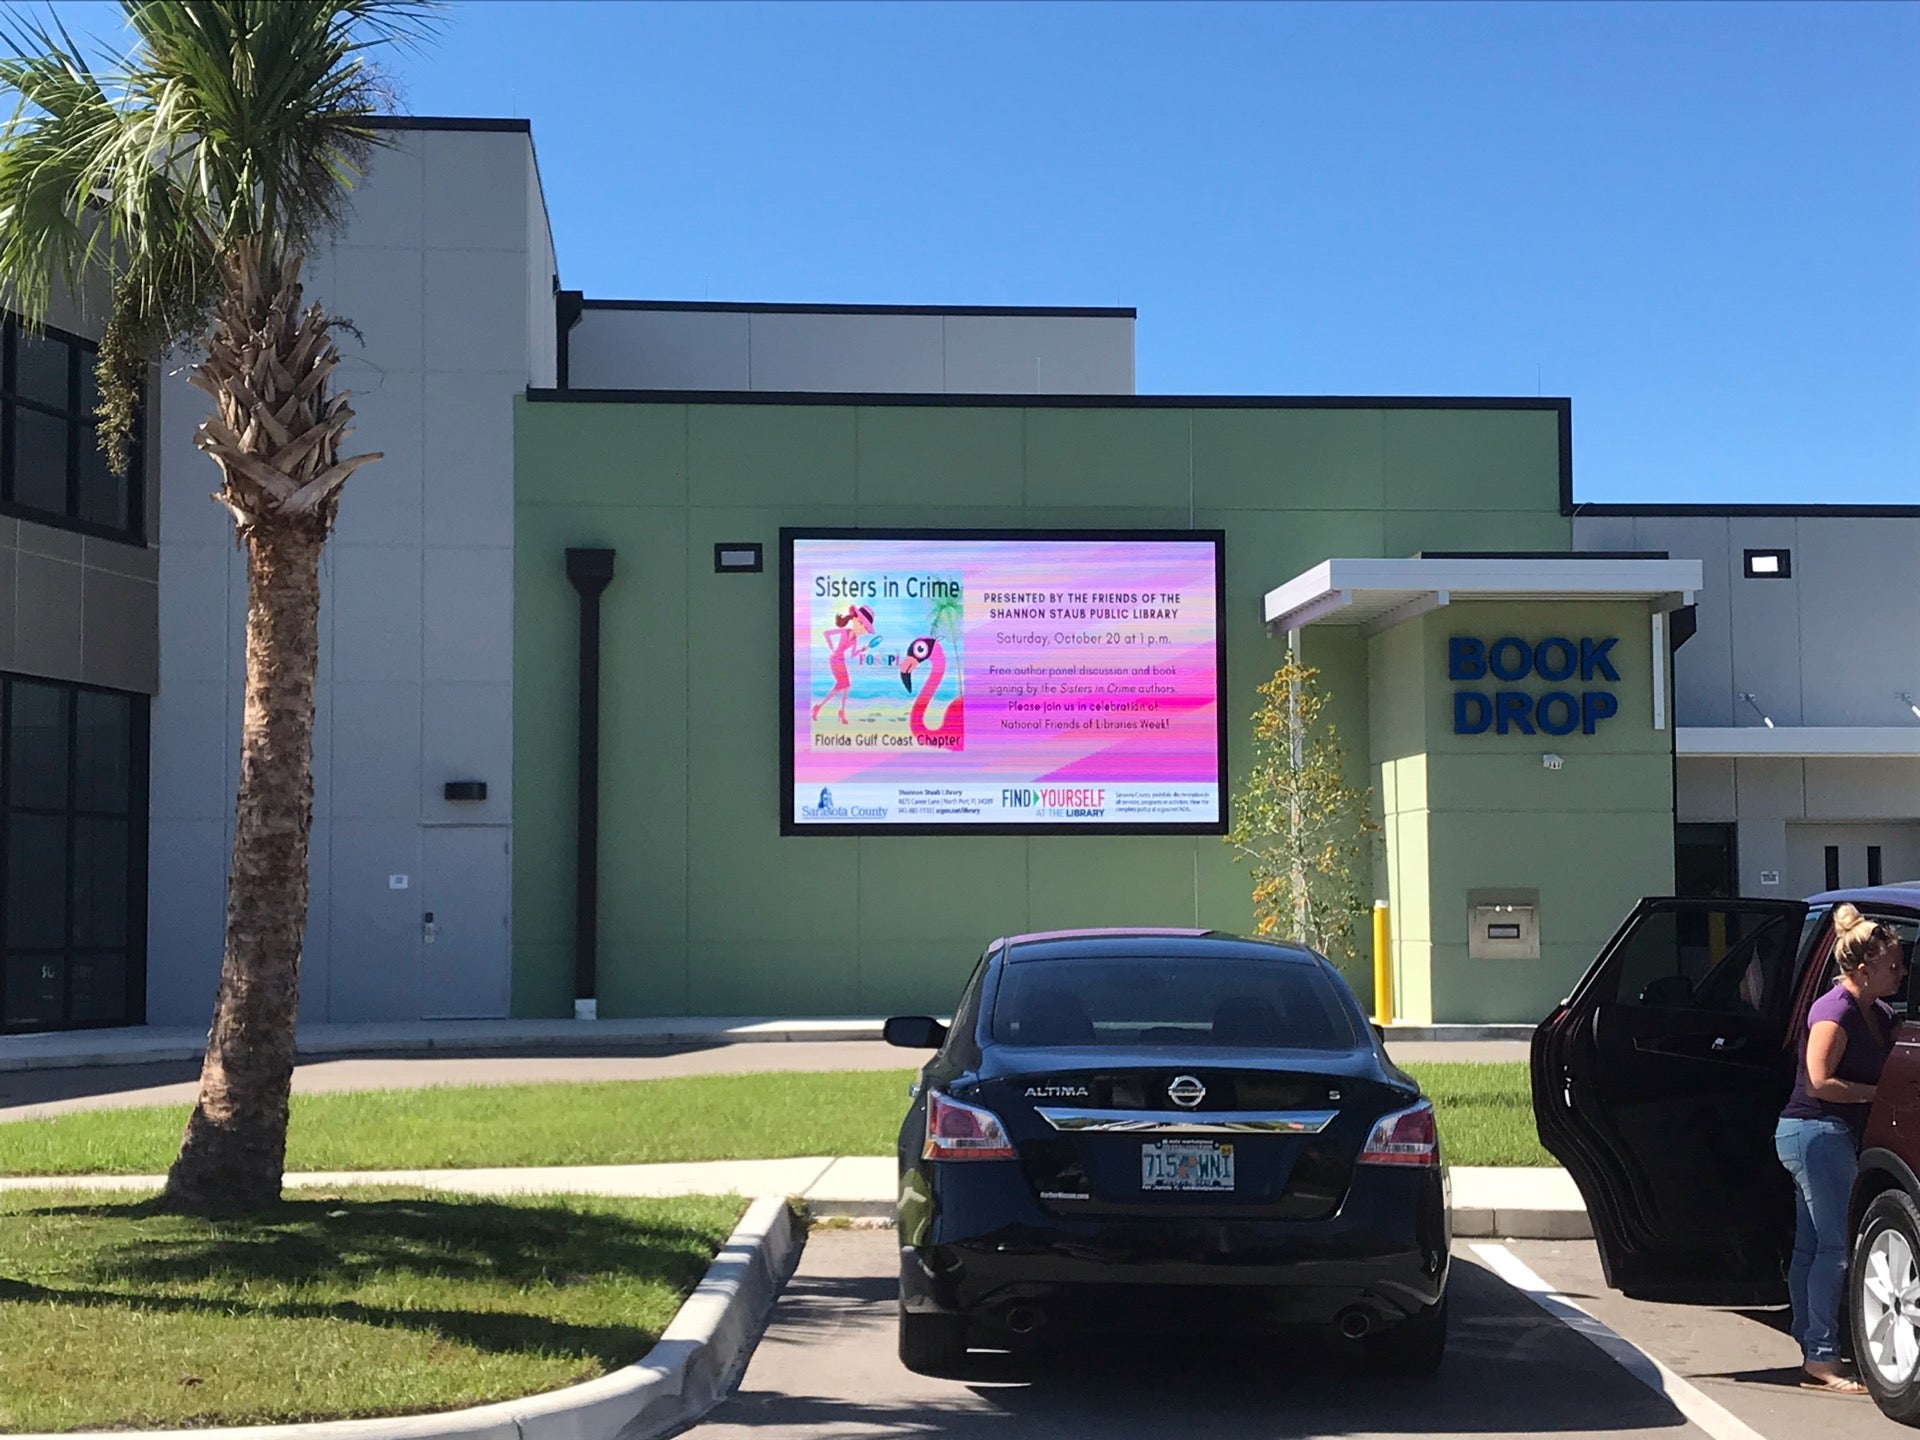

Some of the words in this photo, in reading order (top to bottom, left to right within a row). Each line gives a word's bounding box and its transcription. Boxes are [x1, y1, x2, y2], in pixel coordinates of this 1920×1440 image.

[815, 576, 877, 598] Sisters
[884, 576, 899, 598] in
[906, 576, 960, 598] Crime
[984, 593, 1045, 603] PRESENTED
[1050, 593, 1063, 603] BY
[1068, 593, 1088, 603] THE
[1092, 593, 1138, 603] FRIENDS
[1142, 593, 1156, 603] OF
[1160, 593, 1180, 604] THE
[990, 609, 1045, 619] SHANNON
[1050, 609, 1086, 619] STAUB
[1090, 609, 1128, 619] PUBLIC
[1133, 609, 1178, 619] LIBRARY
[997, 632, 1050, 647] Saturday,
[1054, 632, 1101, 645] October
[1106, 632, 1120, 645] 20
[1124, 633, 1136, 645] at
[1147, 635, 1171, 647] p.m.
[1449, 636, 1621, 682] BOOK
[989, 665, 1011, 675] Free
[1014, 665, 1046, 675] author
[1049, 665, 1076, 678] panel
[1079, 665, 1128, 675] discussion
[1131, 665, 1150, 675] and
[1153, 665, 1176, 675] book
[989, 683, 1023, 696] signing
[1026, 683, 1037, 696] by
[1041, 683, 1057, 693] the
[1060, 683, 1092, 693] Sisters
[1095, 683, 1104, 693] in
[1107, 683, 1136, 693] Crime
[1008, 701, 1041, 711] Please
[1043, 702, 1061, 713] join
[1078, 702, 1087, 711] in
[1090, 701, 1145, 711] celebration
[1148, 701, 1158, 711] of
[1454, 691, 1619, 736] DROP
[1001, 719, 1042, 729] National
[1045, 719, 1080, 729] Friends
[1083, 719, 1092, 729] of
[1096, 719, 1138, 729] Libraries
[1140, 719, 1169, 729] Week!
[815, 734, 851, 746] Florida
[855, 734, 878, 746] Gulf
[882, 734, 913, 746] Coast
[917, 734, 960, 748] Chapter
[1002, 789, 1031, 807] FIND
[1040, 789, 1105, 808] YOURSELF
[851, 805, 888, 817] County
[1036, 809, 1046, 817] AT
[1049, 809, 1064, 817] THE
[1066, 809, 1105, 817] LIBRARY
[1025, 1086, 1089, 1097] ALTIMA
[1329, 1090, 1340, 1100] S
[1143, 1154, 1177, 1178] 715
